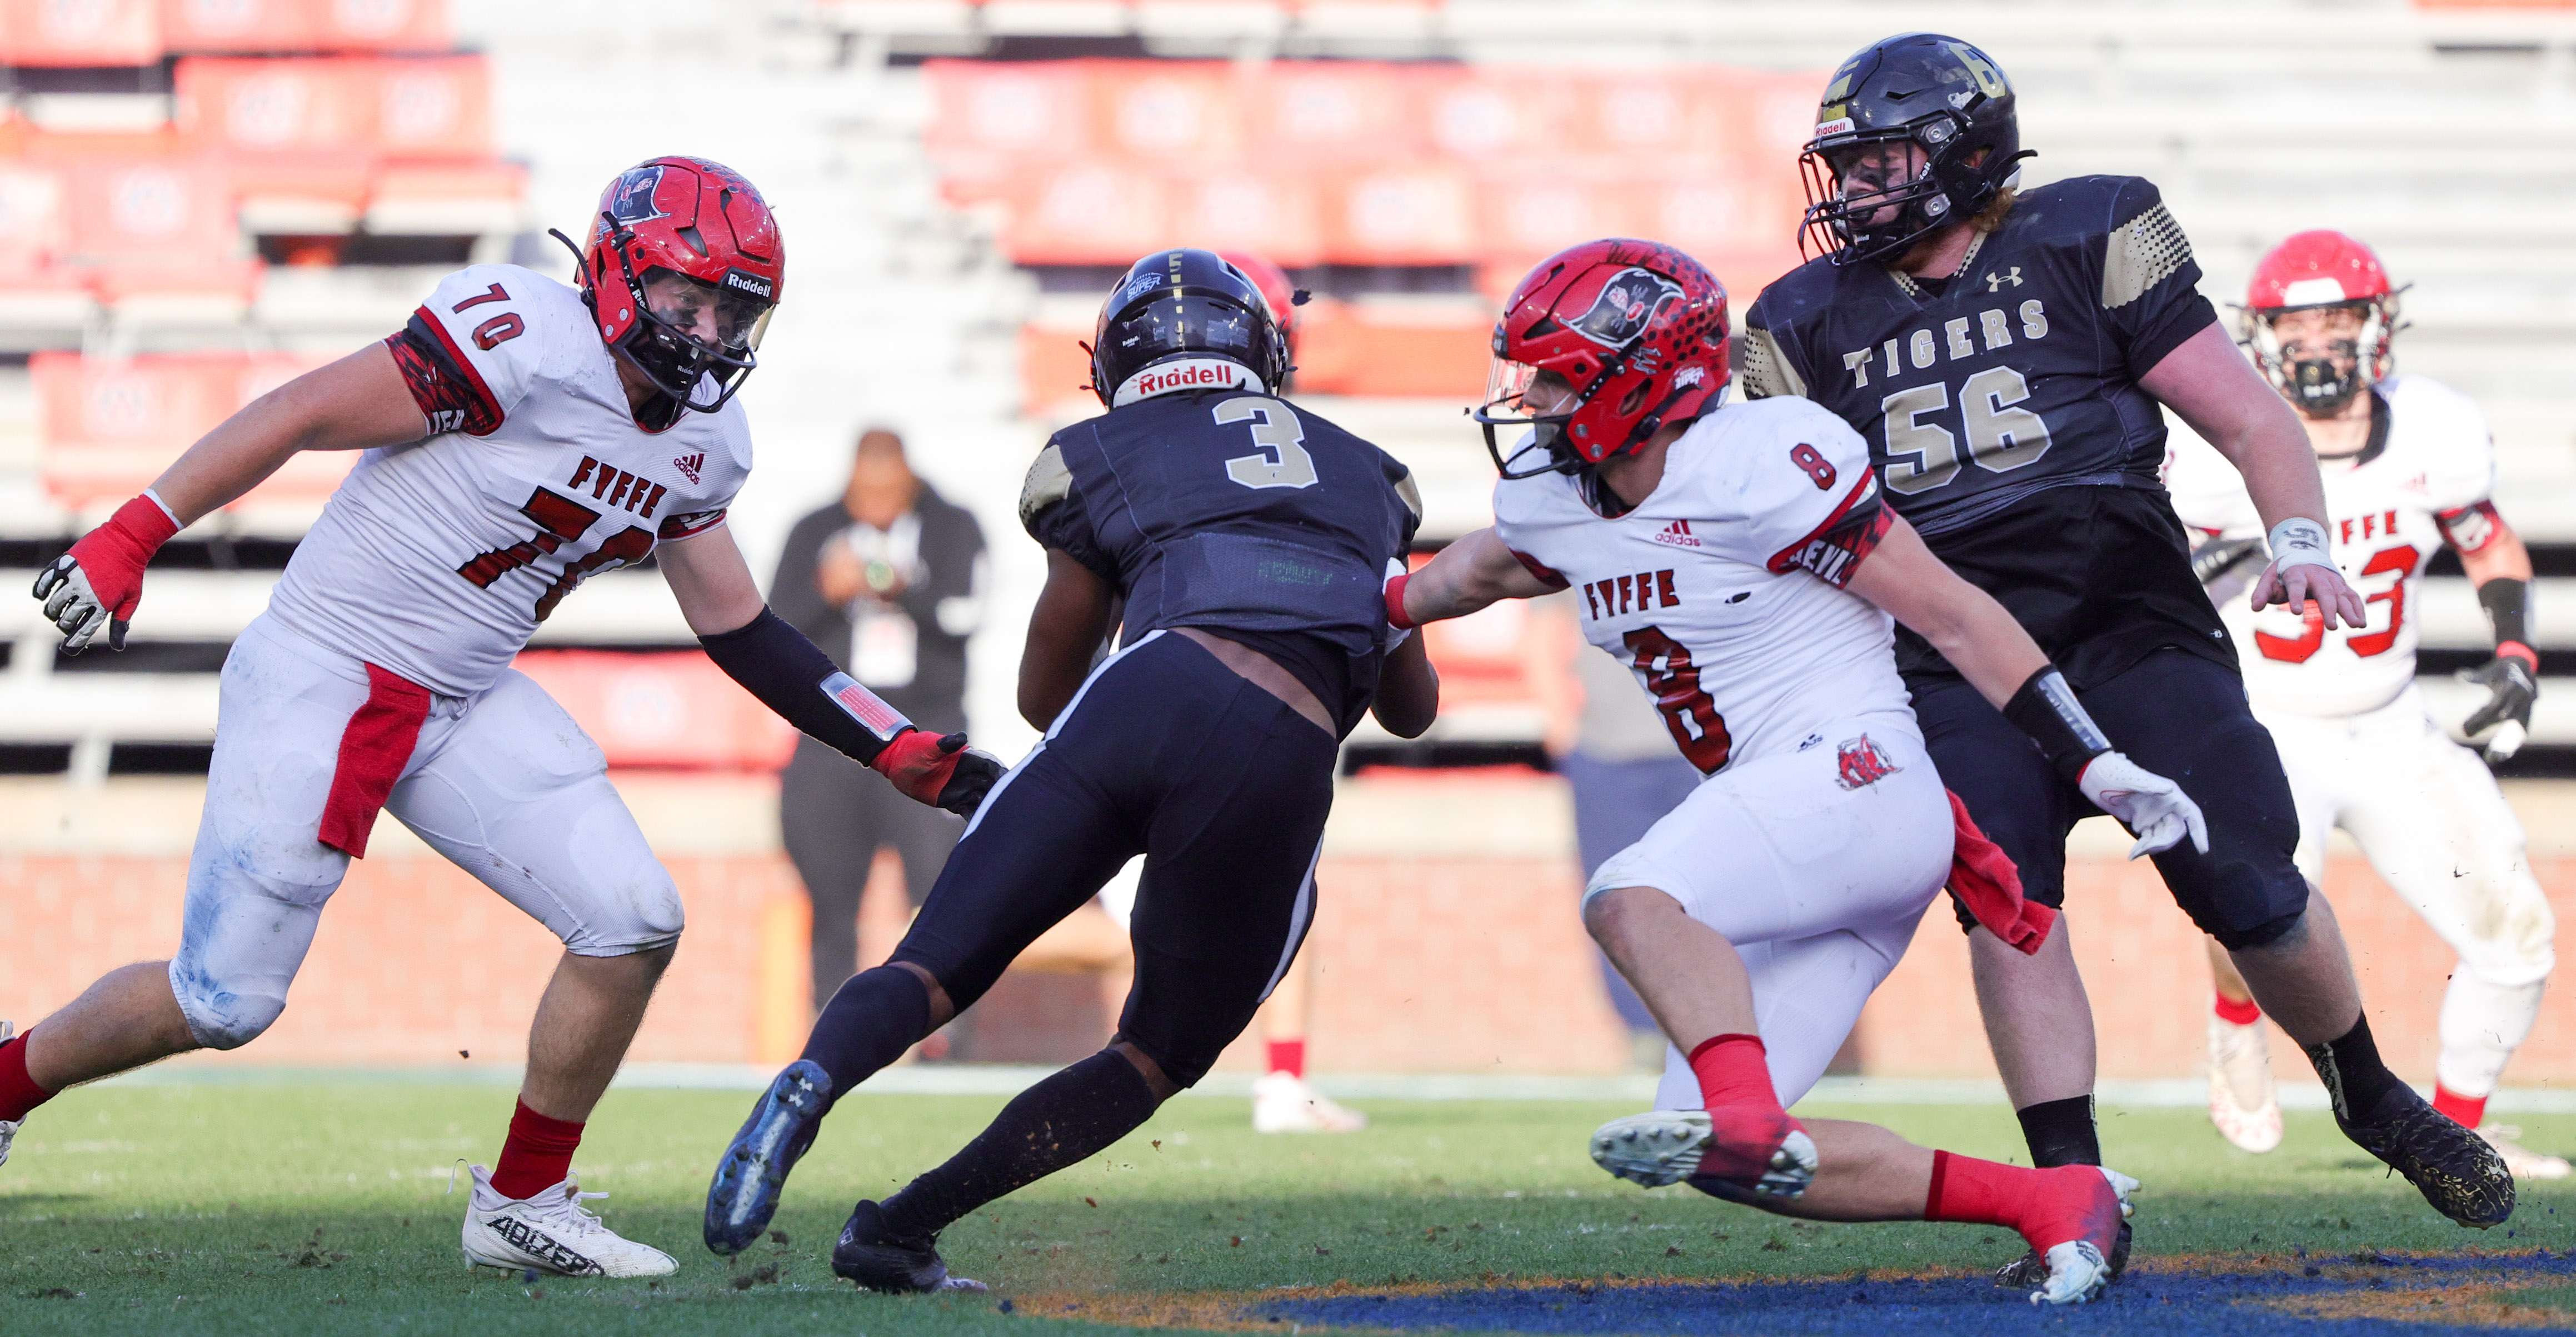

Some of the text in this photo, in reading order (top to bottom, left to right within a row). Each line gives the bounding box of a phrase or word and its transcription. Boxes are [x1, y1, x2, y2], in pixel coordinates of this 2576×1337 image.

[727, 273, 771, 298] Riddell
[452, 282, 525, 351] 70
[1843, 299, 2048, 389] TIGERS
[1139, 365, 1232, 395] Riddell
[1212, 396, 1319, 490] 3
[1881, 366, 2053, 496] 56
[567, 455, 667, 520] FYFFE
[674, 457, 700, 485] adidas
[1790, 443, 1836, 491] 8
[1655, 533, 1701, 547] adidas
[2340, 510, 2396, 544] FFE
[1584, 568, 1681, 621] FYFFE
[1623, 625, 1733, 776] 8
